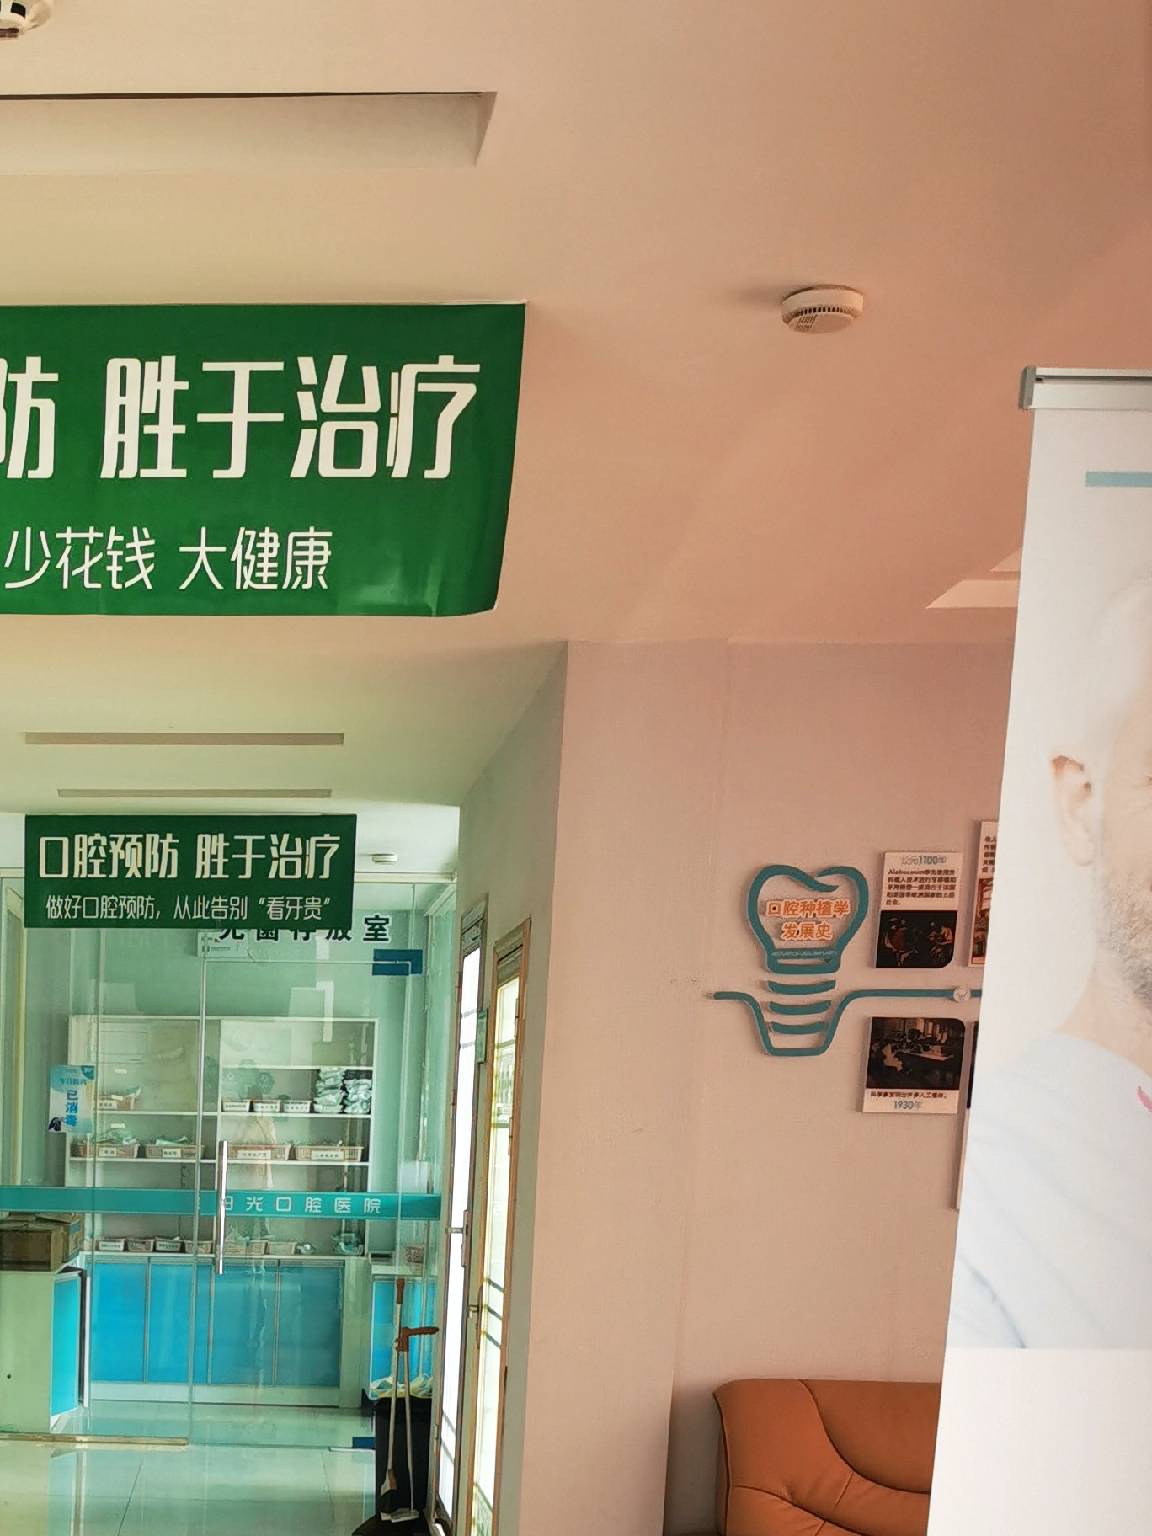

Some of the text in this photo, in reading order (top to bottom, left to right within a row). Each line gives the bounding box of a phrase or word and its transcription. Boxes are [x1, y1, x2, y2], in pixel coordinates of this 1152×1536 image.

[100, 354, 481, 480] 胜于治疗
[3, 526, 156, 590] 少花钱
[178, 526, 334, 590] 大健康
[39, 833, 341, 879] 口腔预防 胜于治疗
[767, 899, 851, 918] 口腔种植学
[782, 921, 832, 940] 发展史
